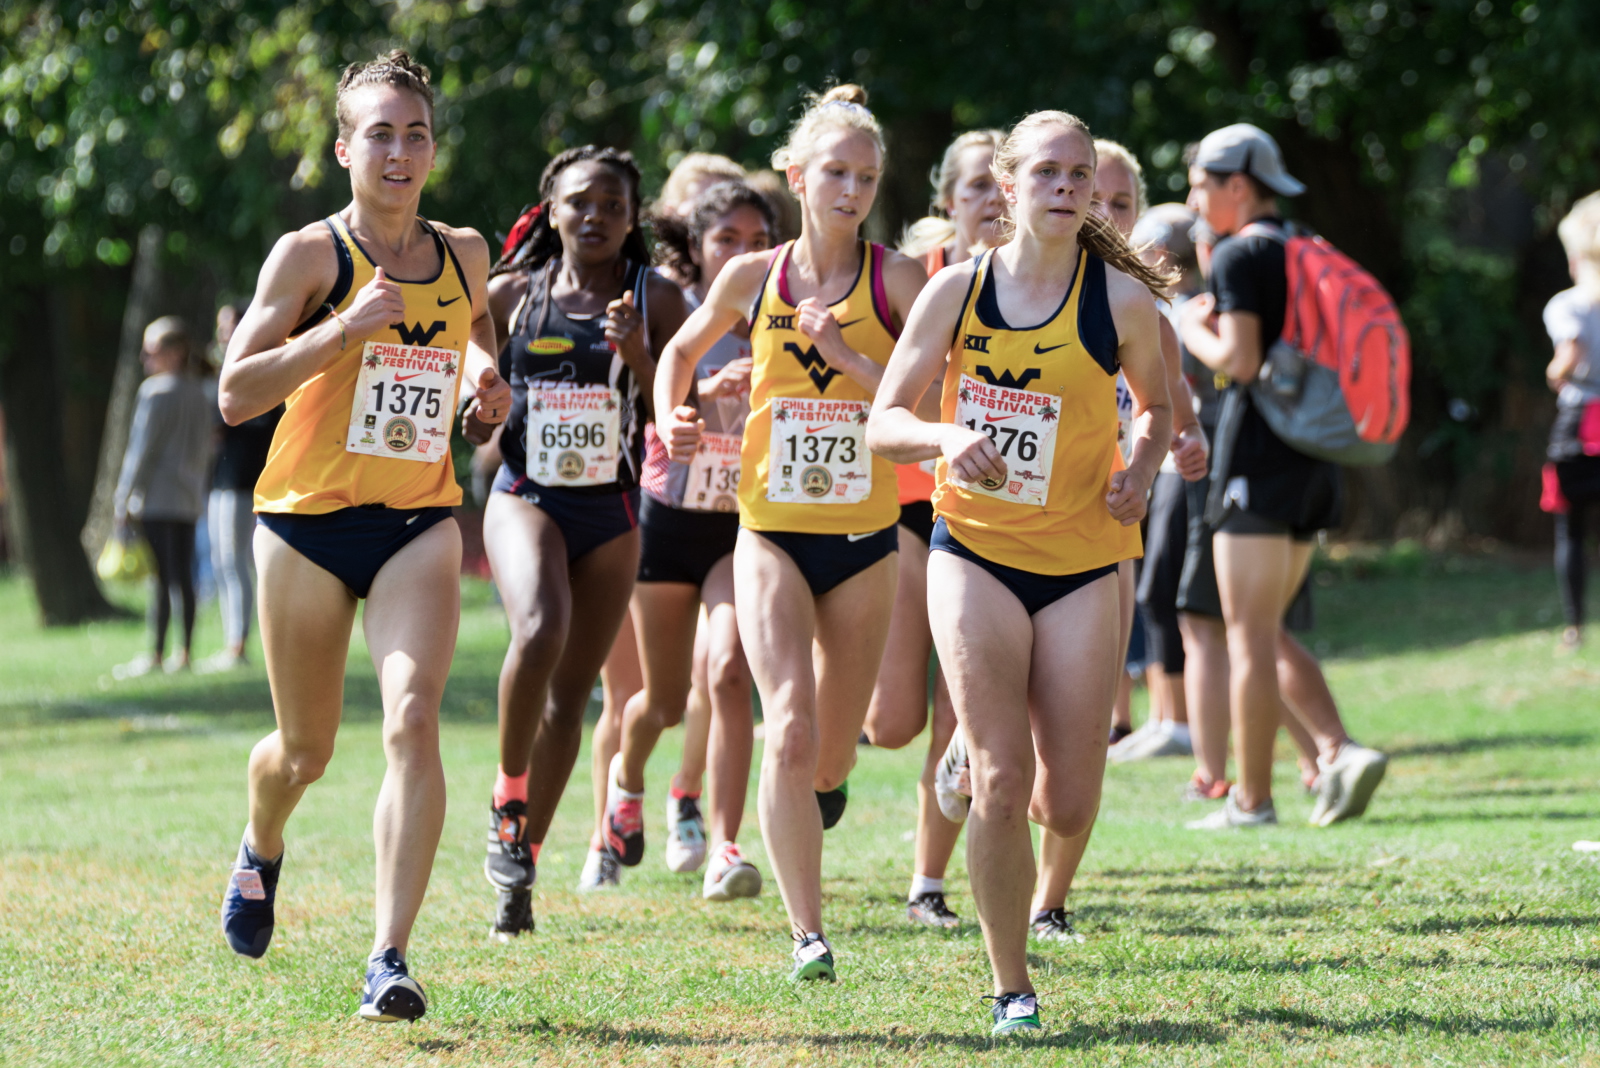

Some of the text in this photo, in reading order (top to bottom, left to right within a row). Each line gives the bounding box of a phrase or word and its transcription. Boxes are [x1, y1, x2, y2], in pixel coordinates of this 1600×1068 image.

[373, 345, 452, 362] CHILE PEPPER
[382, 357, 441, 373] FESTIVAL
[372, 381, 442, 419] 1375
[536, 391, 611, 401] CHILE PEPPER
[965, 379, 1051, 407] CHILE PEPPER
[546, 400, 600, 411] FESTIVAL
[781, 400, 863, 413] CHILE PEPPER
[972, 394, 1035, 416] FESTIVAL
[792, 411, 851, 423] FESTIVAL
[541, 423, 606, 449] 6596
[786, 434, 857, 464] 1373
[702, 465, 741, 493] 139
